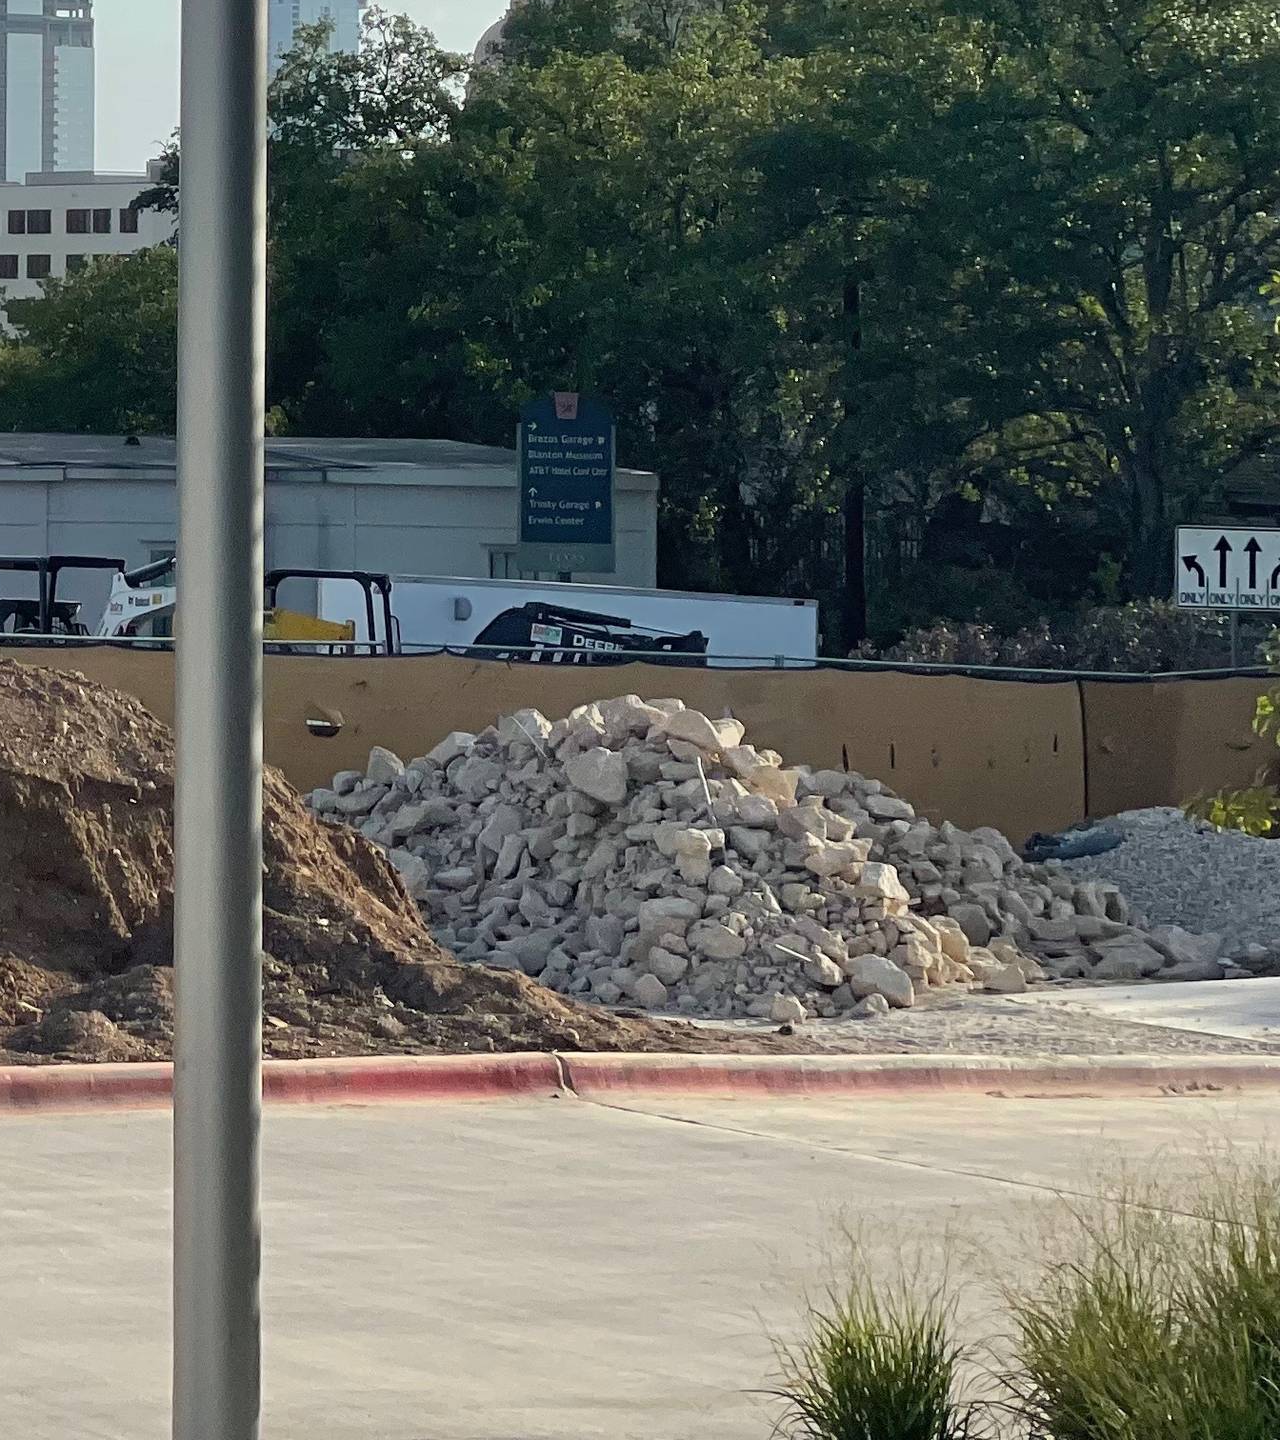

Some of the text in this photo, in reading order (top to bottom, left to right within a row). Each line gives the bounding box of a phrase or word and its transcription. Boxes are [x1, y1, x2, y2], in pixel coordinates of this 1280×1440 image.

[528, 434, 558, 443] Brazos
[561, 434, 594, 445] Garage
[528, 450, 603, 459] Blanton Museum
[529, 466, 549, 474] AT&T
[551, 466, 571, 474] Hotel
[559, 501, 590, 510] Garage
[528, 516, 585, 525] Erwin Center
[1180, 592, 1205, 604] ONLY
[1209, 593, 1234, 604] ONLY
[1240, 593, 1266, 605] ONLY
